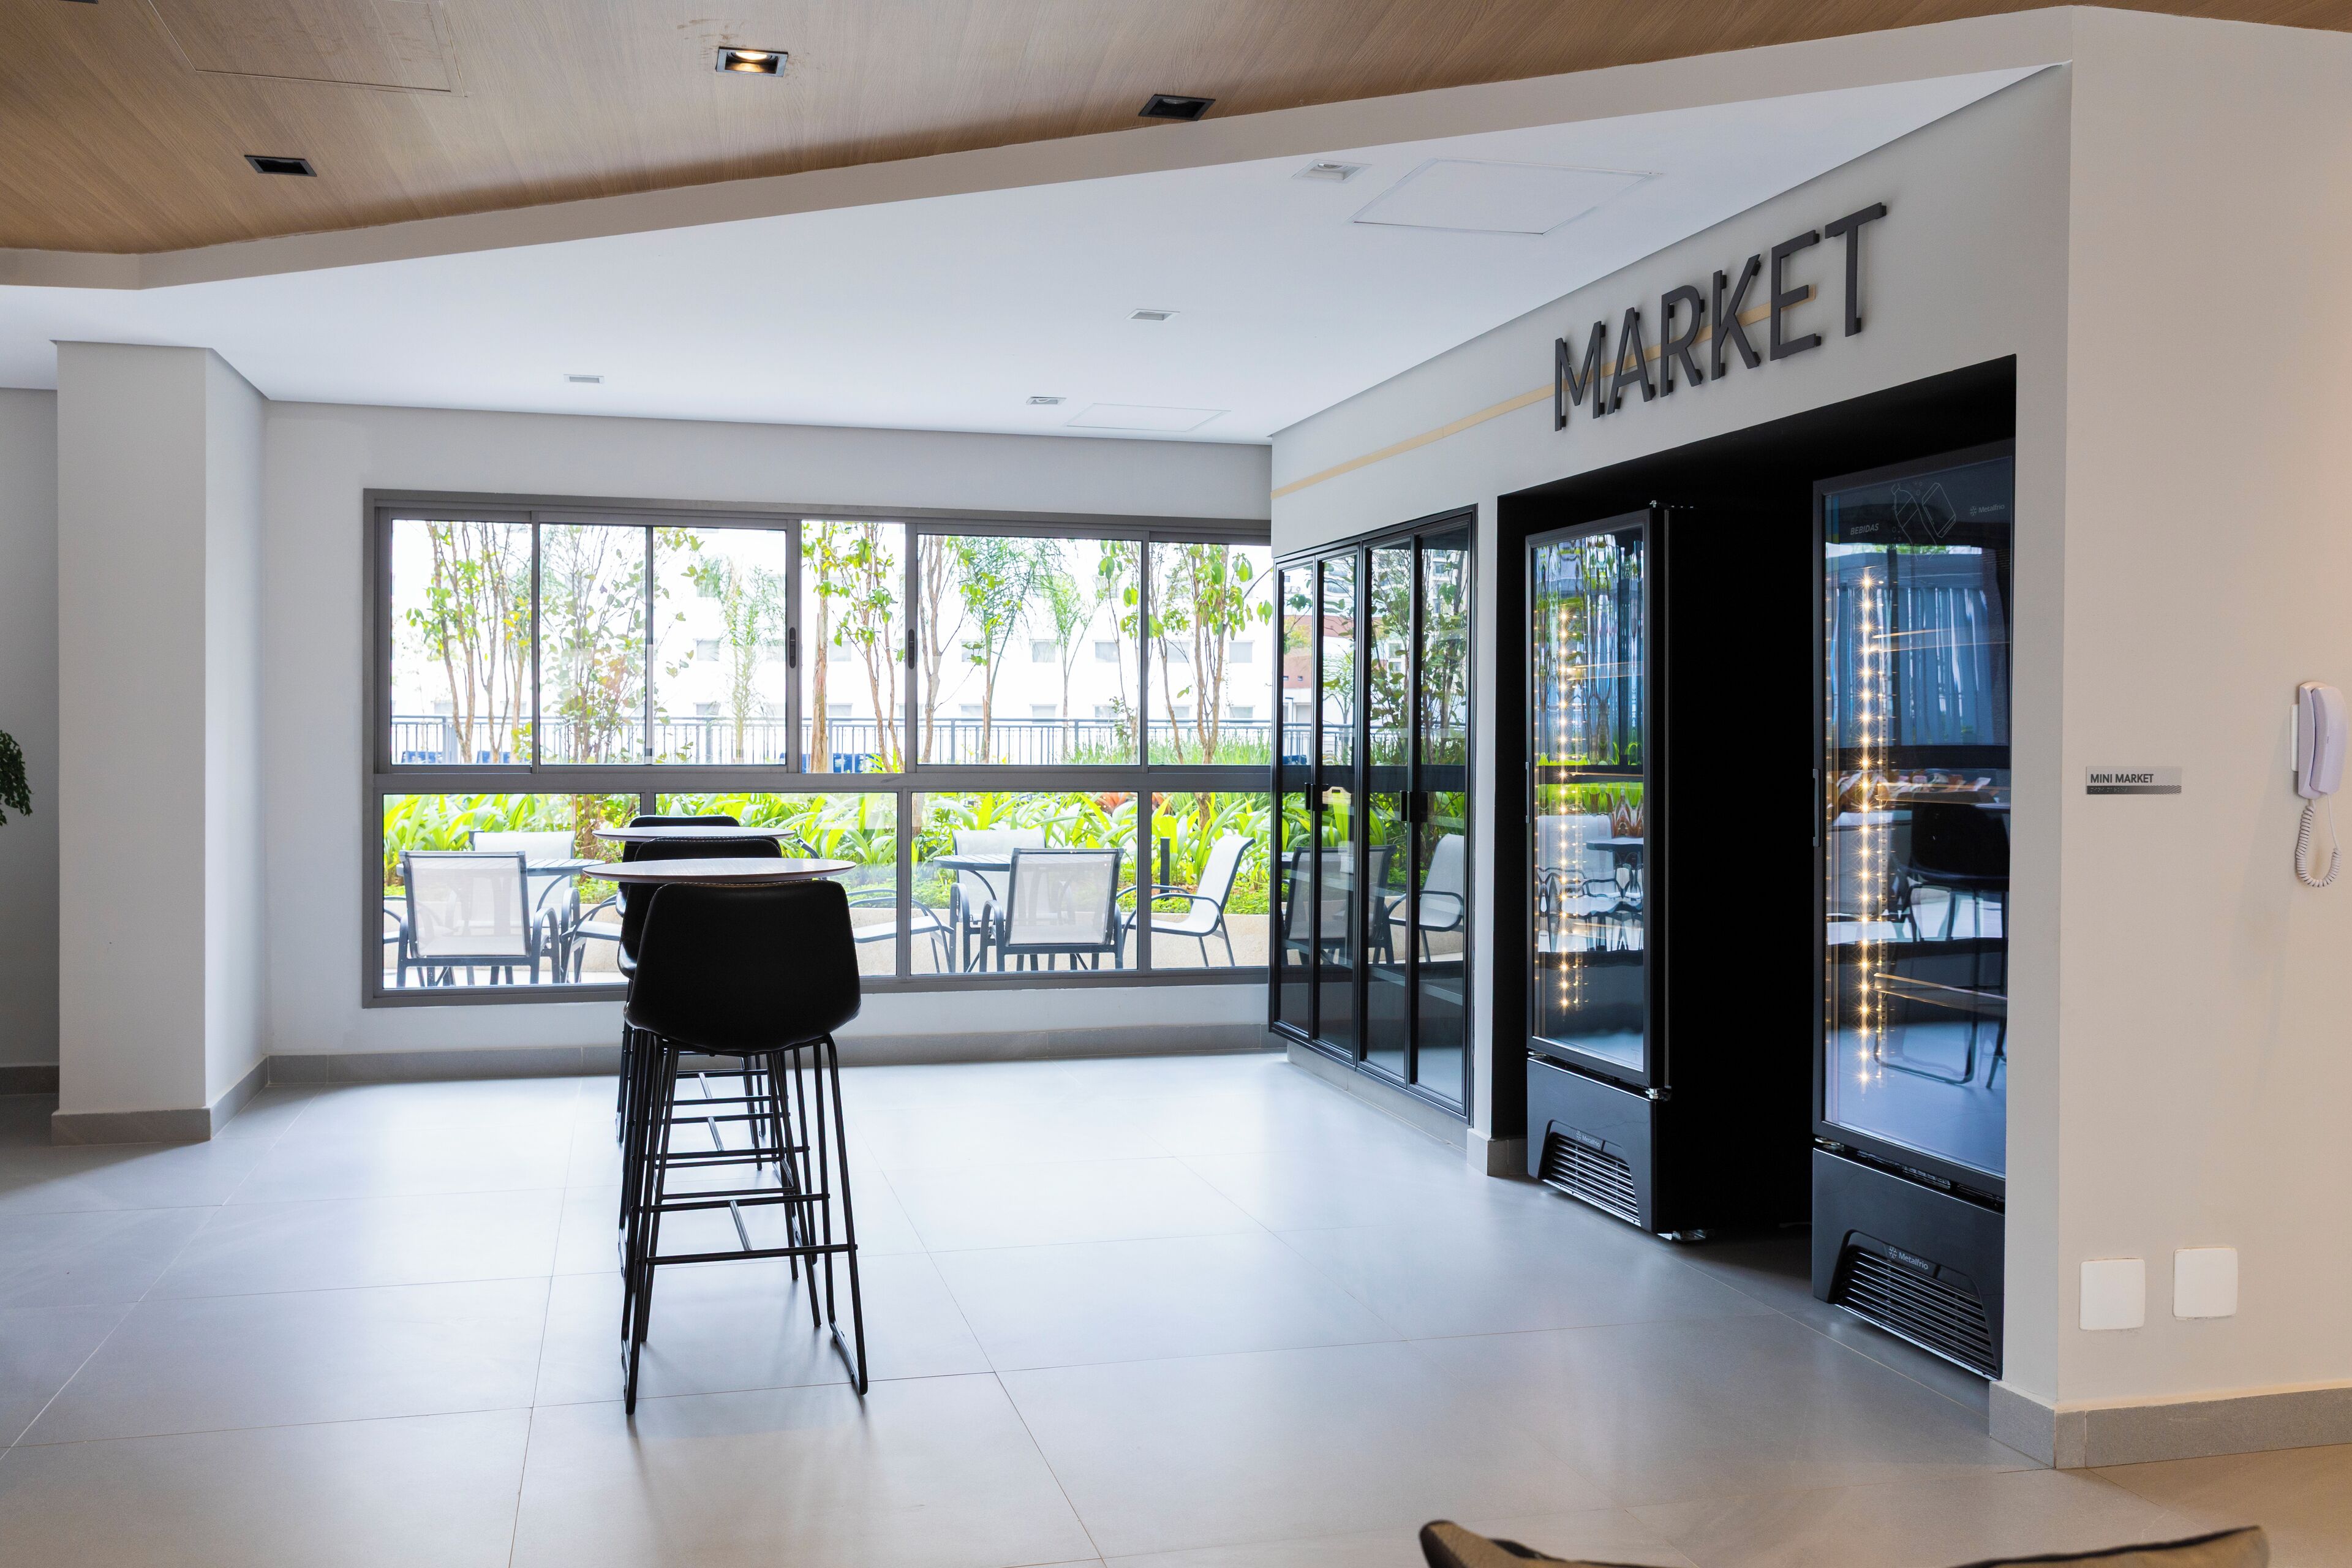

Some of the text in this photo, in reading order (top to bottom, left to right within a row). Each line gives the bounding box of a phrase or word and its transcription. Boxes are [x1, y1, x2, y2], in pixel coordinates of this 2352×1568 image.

[1555, 202, 1887, 432] MARKET
[1978, 503, 2005, 513] Metalfrio
[1850, 523, 1879, 535] BEBIDAS
[2090, 774, 2154, 783] MINI MARKET
[1582, 1135, 1600, 1147] Metalfrio
[1898, 1252, 1929, 1270] Metalfrio
